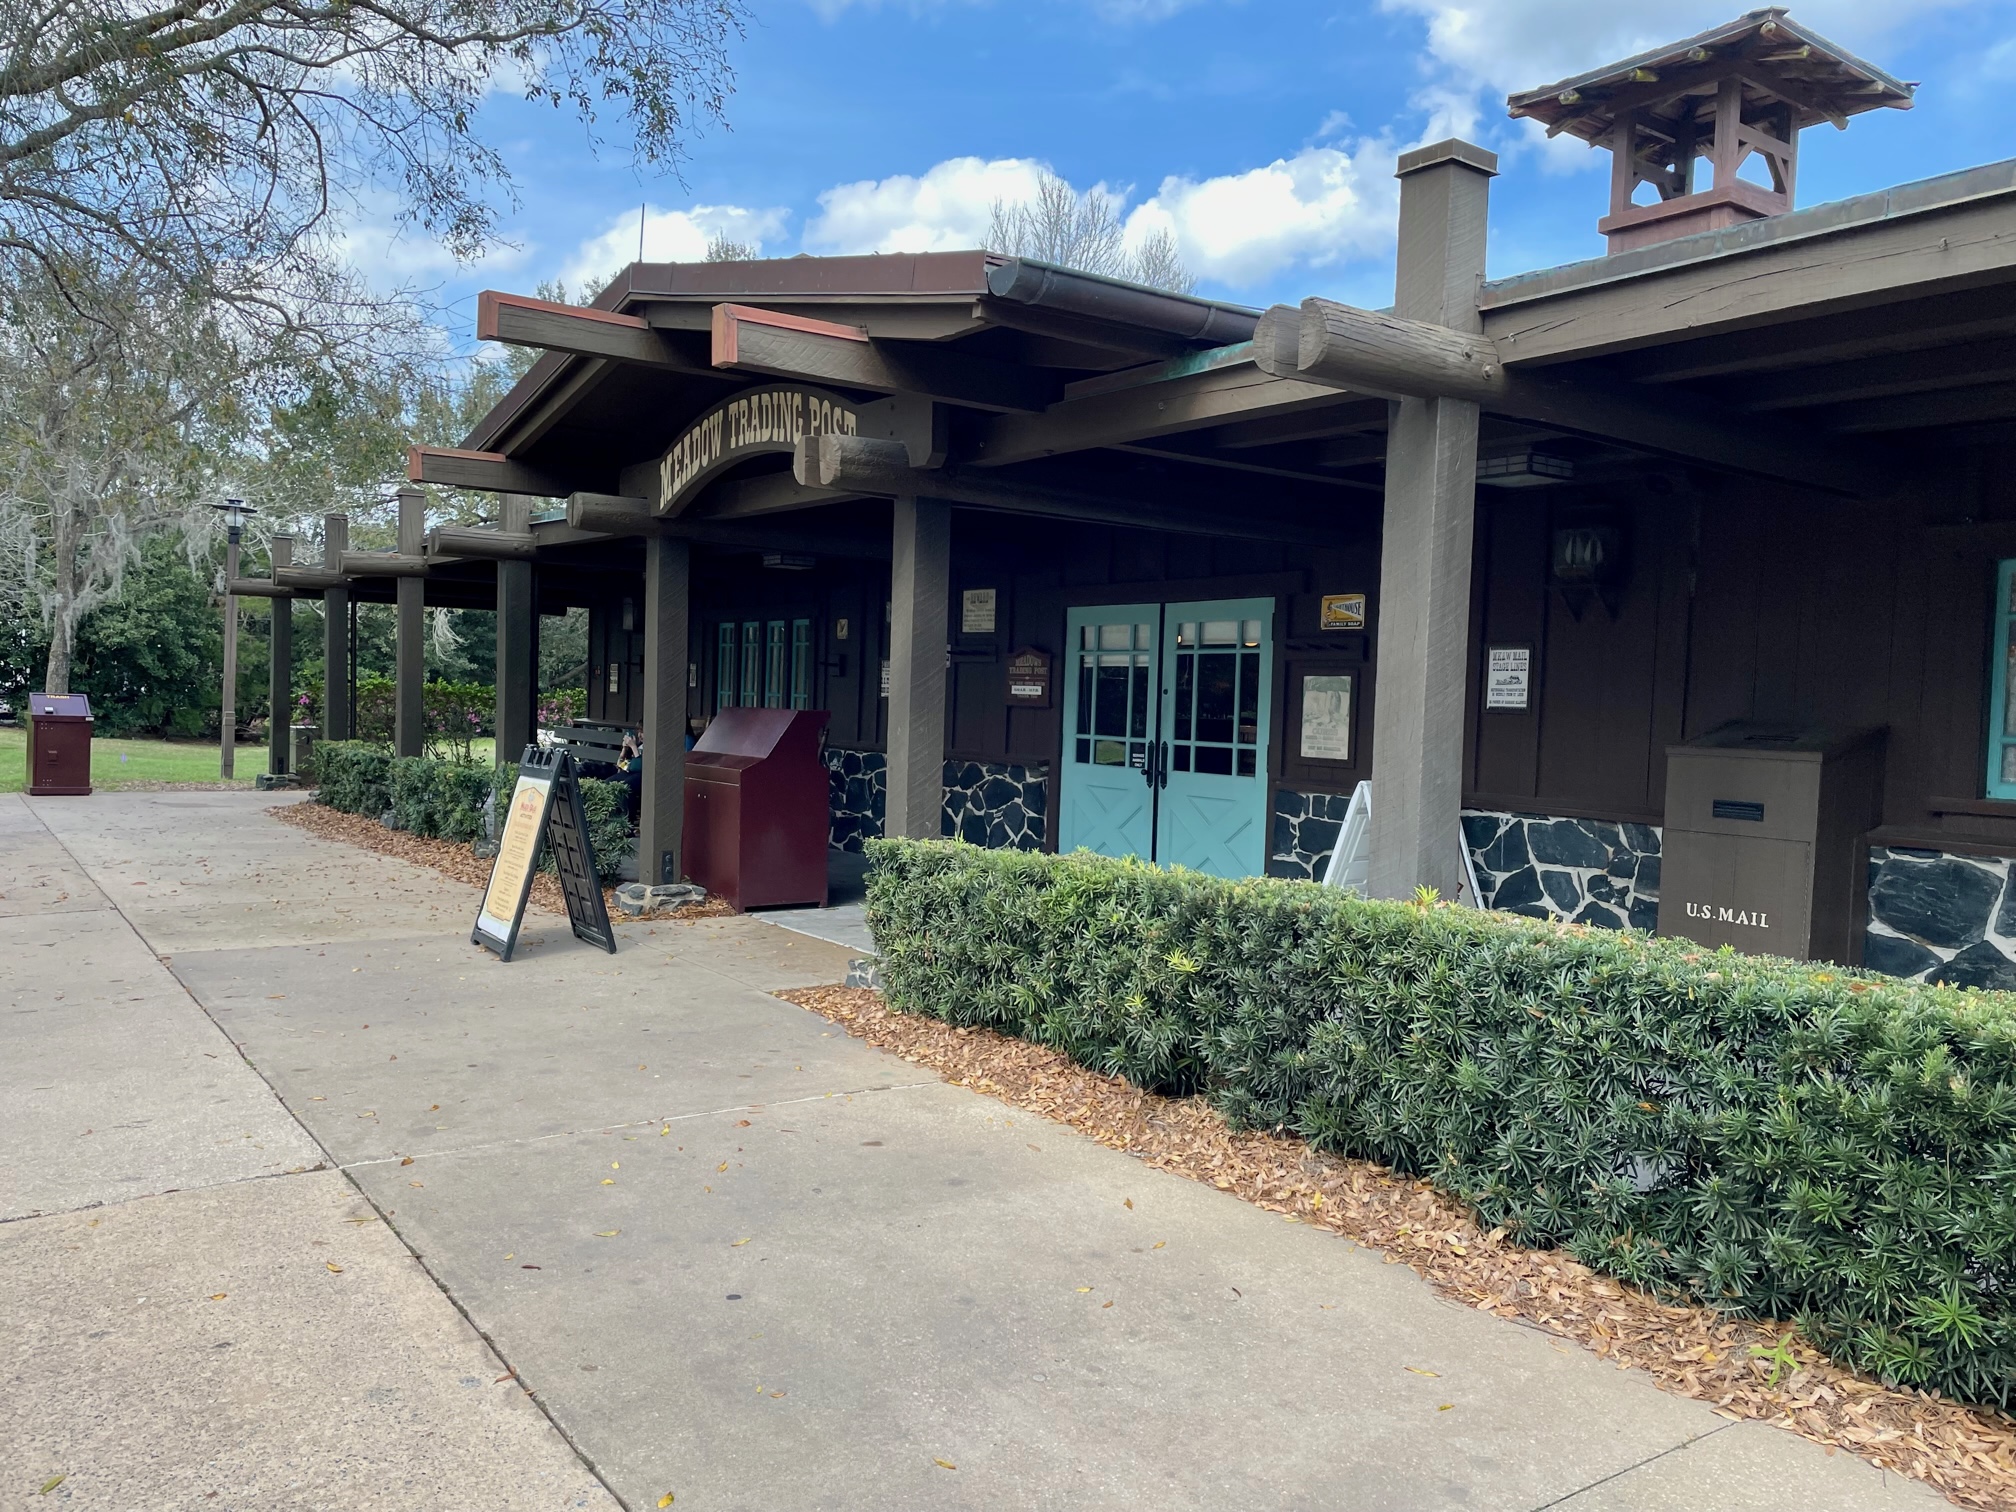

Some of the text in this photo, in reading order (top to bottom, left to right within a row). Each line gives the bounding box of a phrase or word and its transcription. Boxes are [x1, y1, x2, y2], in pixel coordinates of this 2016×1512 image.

[659, 391, 857, 511] MEADOW TRADING POST
[1034, 667, 1048, 675] POST
[1718, 906, 1769, 928] MAIL
